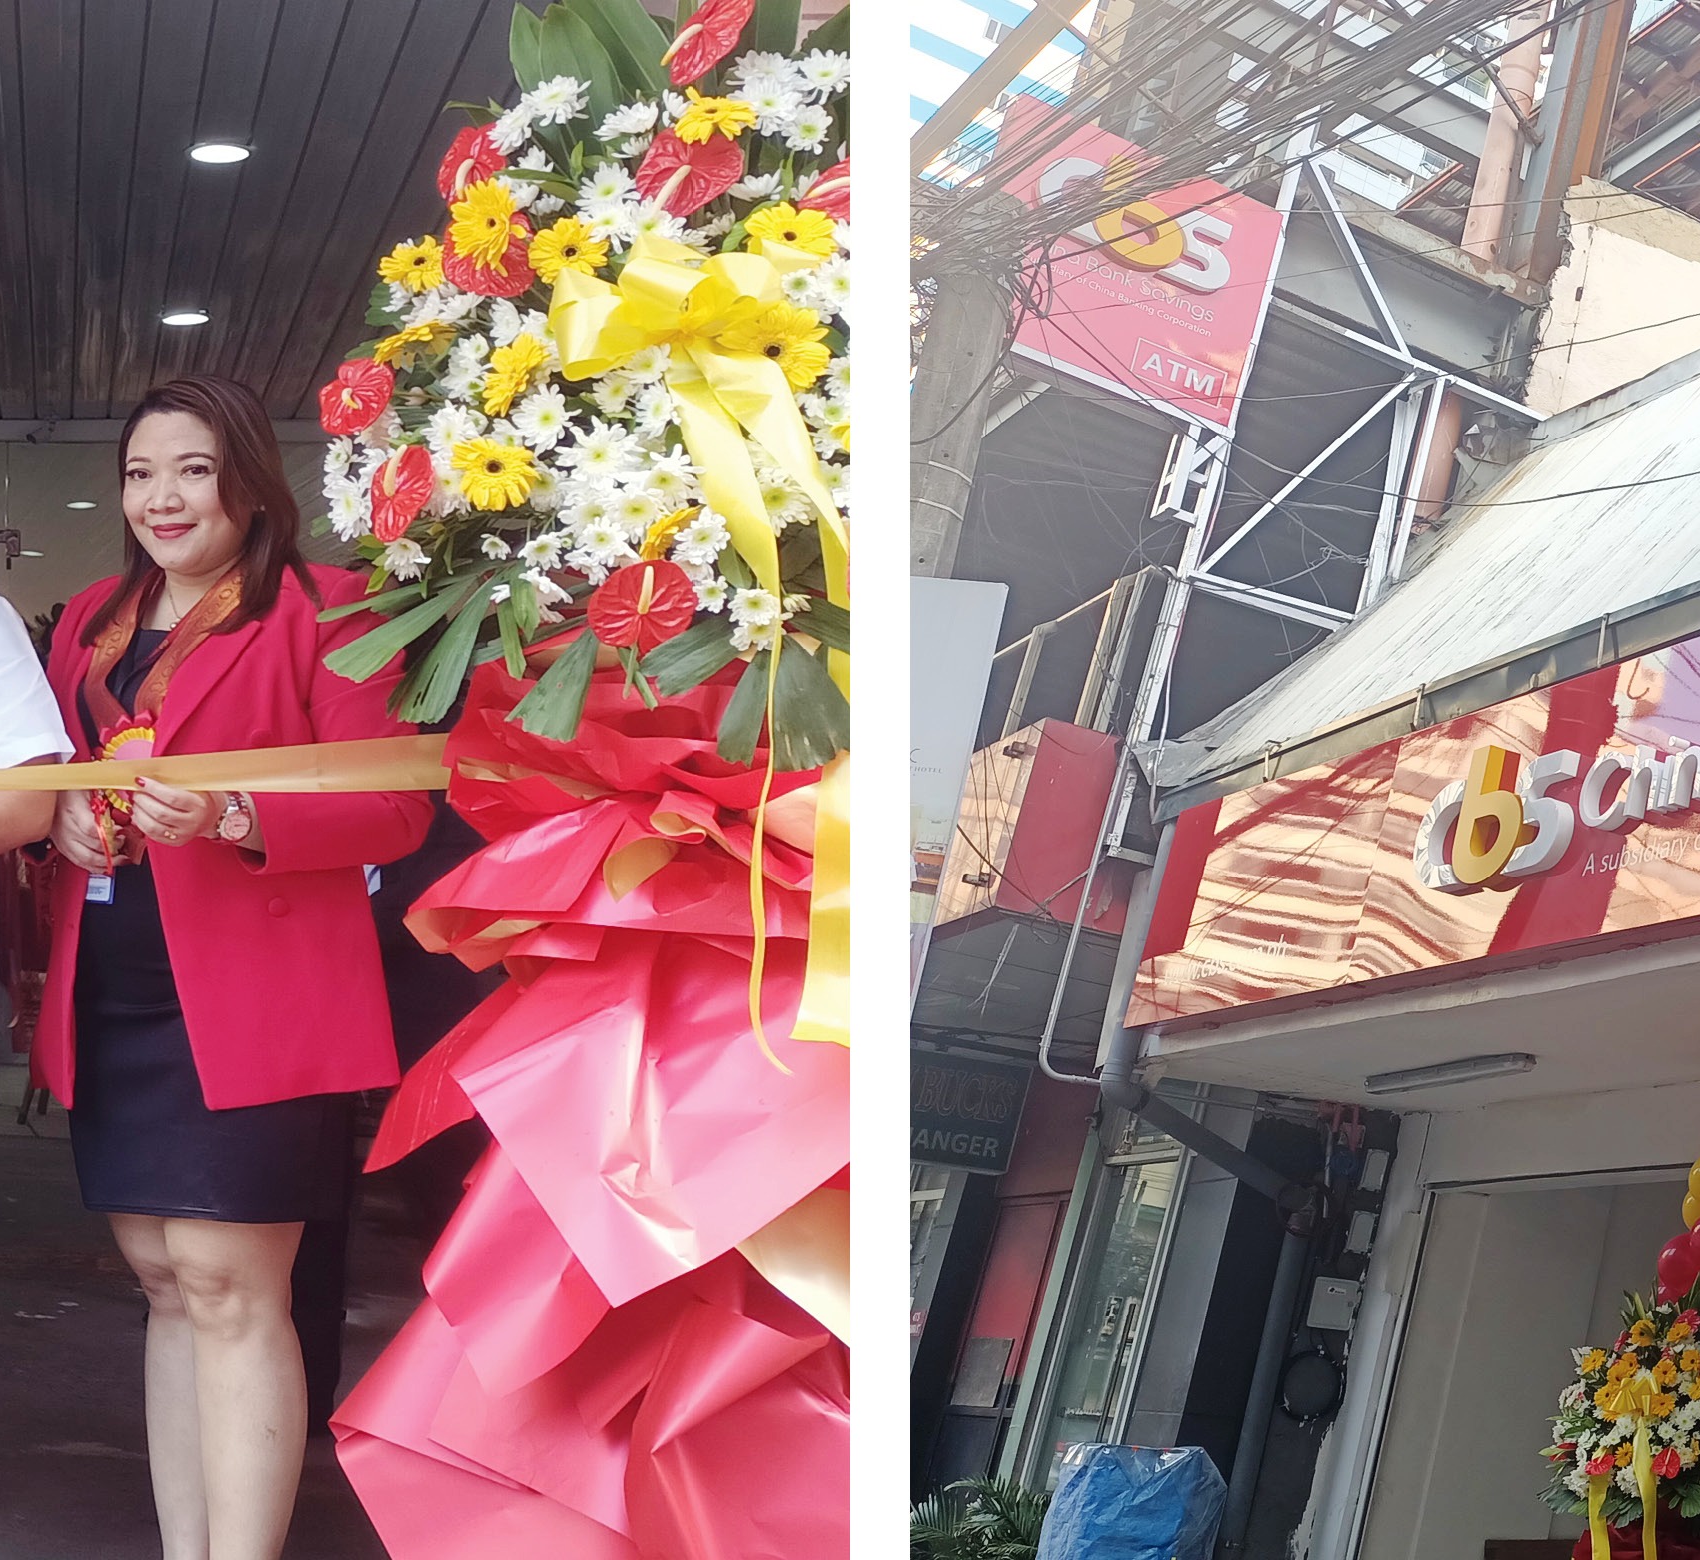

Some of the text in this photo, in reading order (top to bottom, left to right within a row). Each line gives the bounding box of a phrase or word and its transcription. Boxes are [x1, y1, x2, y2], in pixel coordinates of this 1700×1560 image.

[1076, 277, 1087, 285] of
[1089, 280, 1115, 297] China
[1118, 292, 1154, 315] Banking
[1157, 309, 1211, 337] Corporation
[1085, 255, 1134, 289] Bank
[1139, 277, 1215, 322] Savings
[1141, 352, 1216, 397] ATM
[1582, 859, 1595, 877] A
[1599, 833, 1690, 873] subsidiary
[911, 1127, 999, 1158] ANGER
